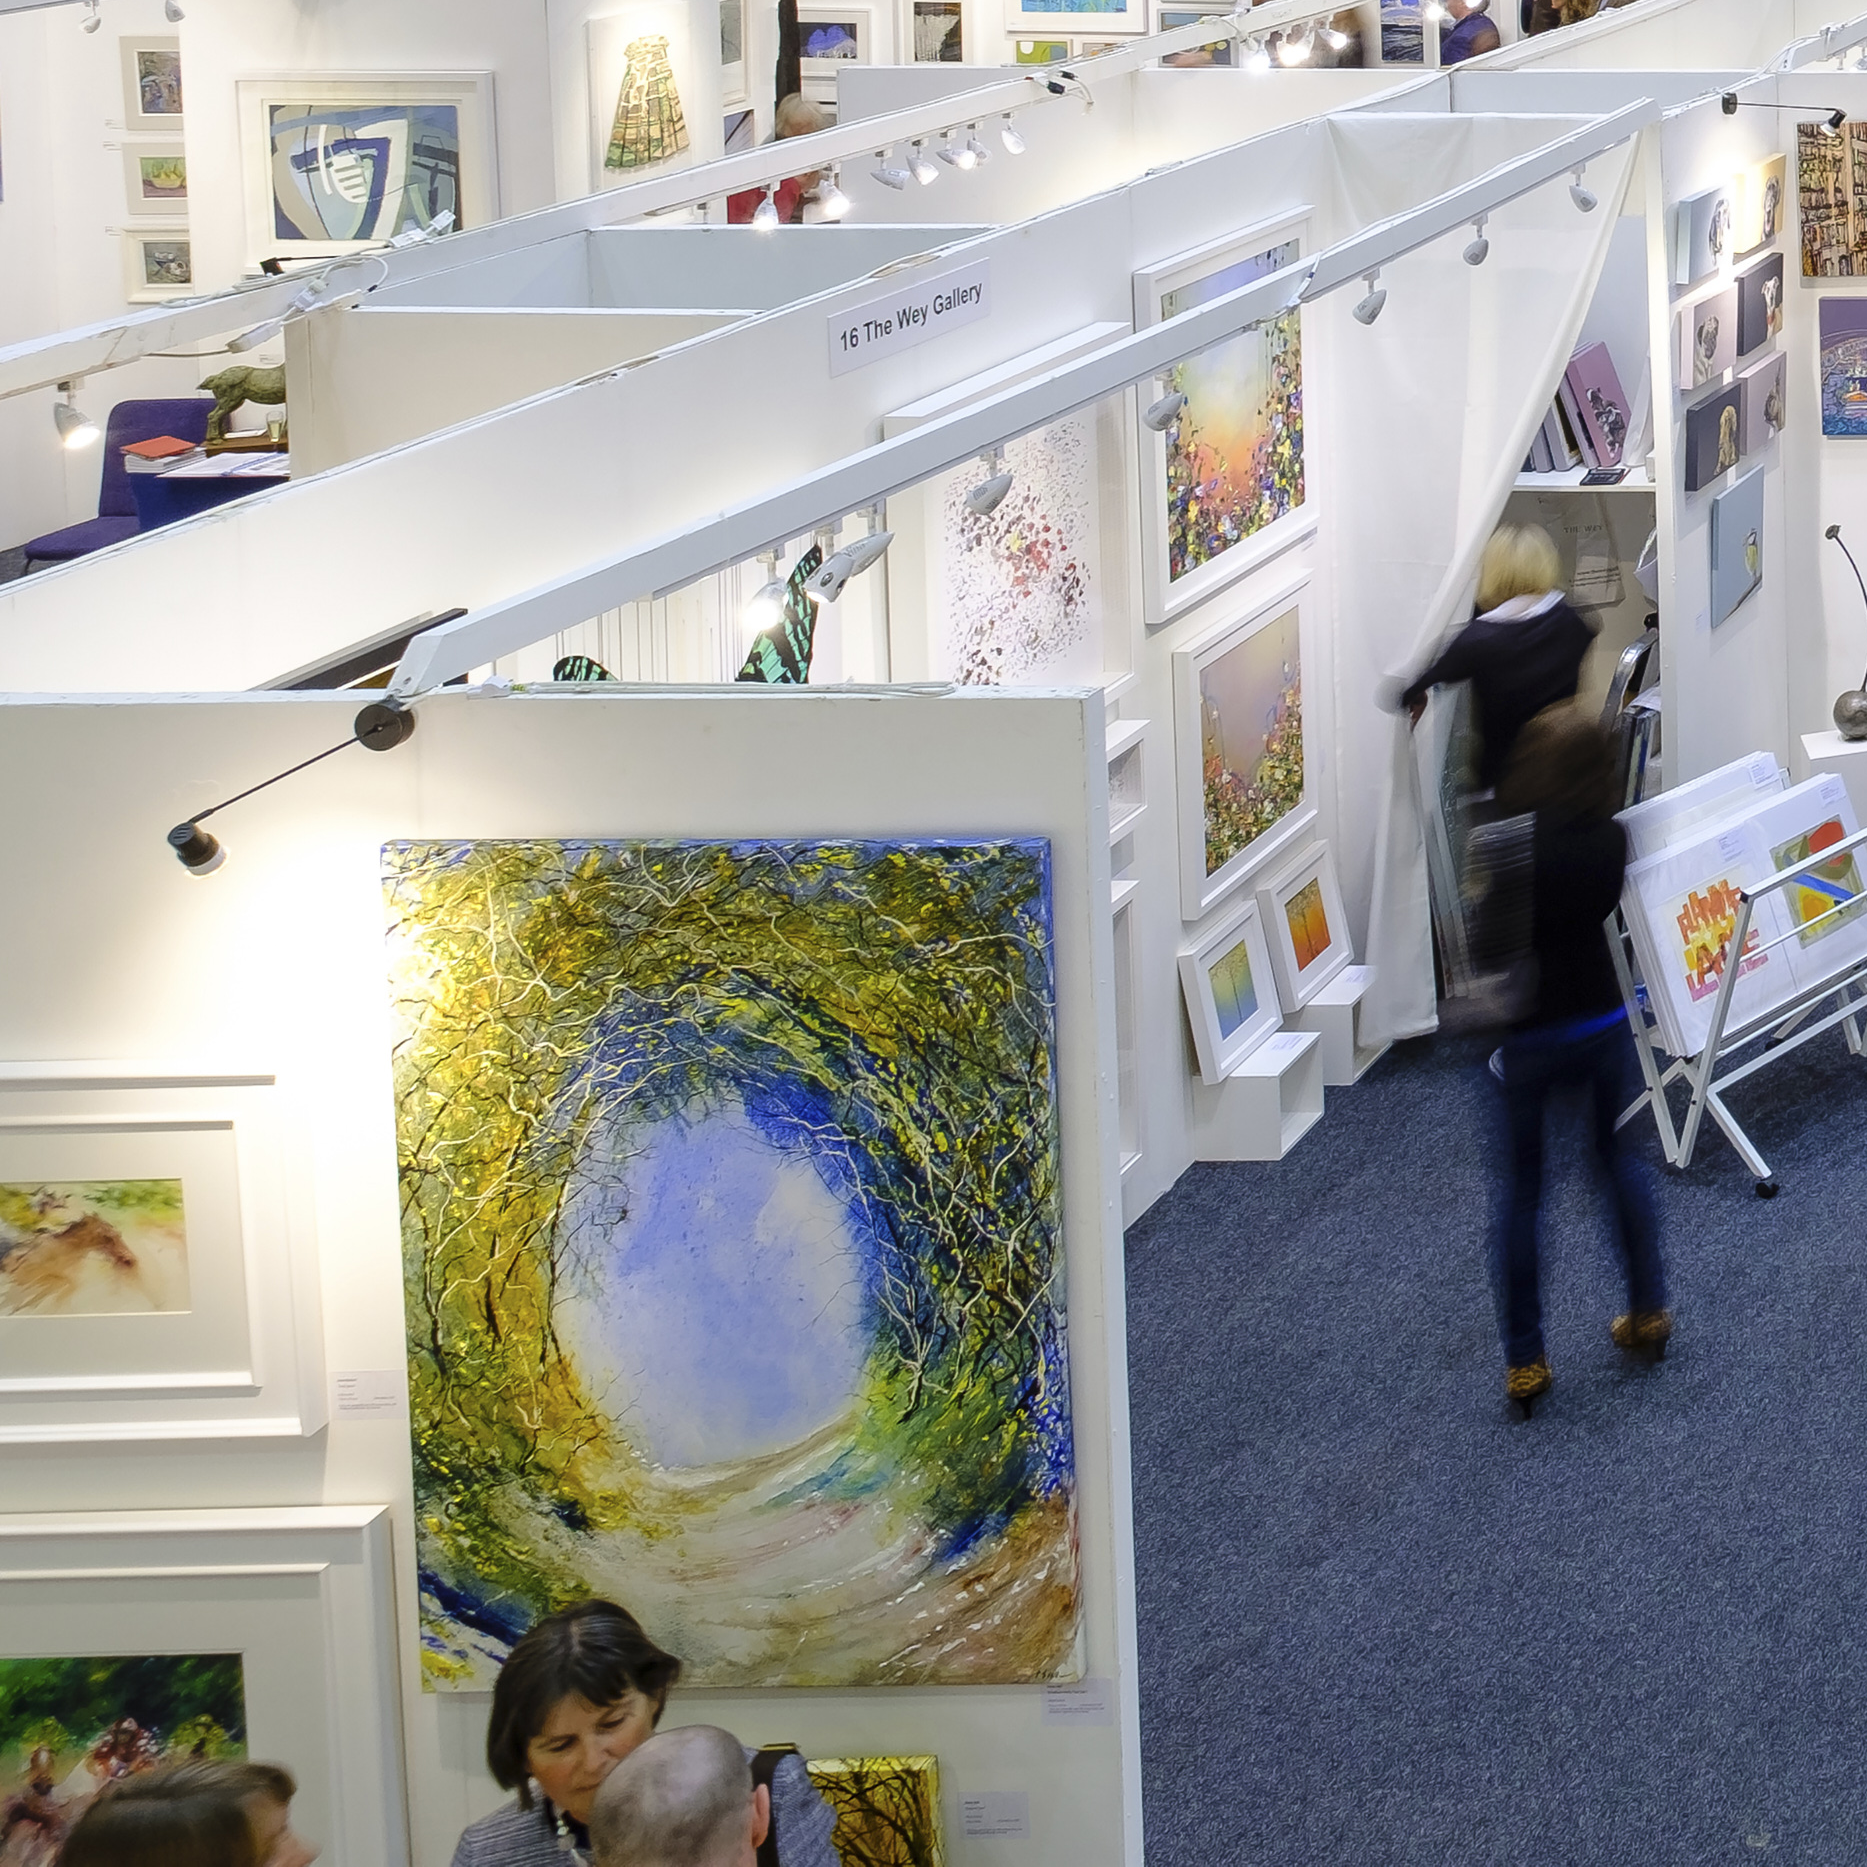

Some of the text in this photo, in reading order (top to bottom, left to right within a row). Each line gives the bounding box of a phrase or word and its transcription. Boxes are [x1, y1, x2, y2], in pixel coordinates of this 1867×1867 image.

[840, 282, 983, 352] 16 The Wey Gallery
